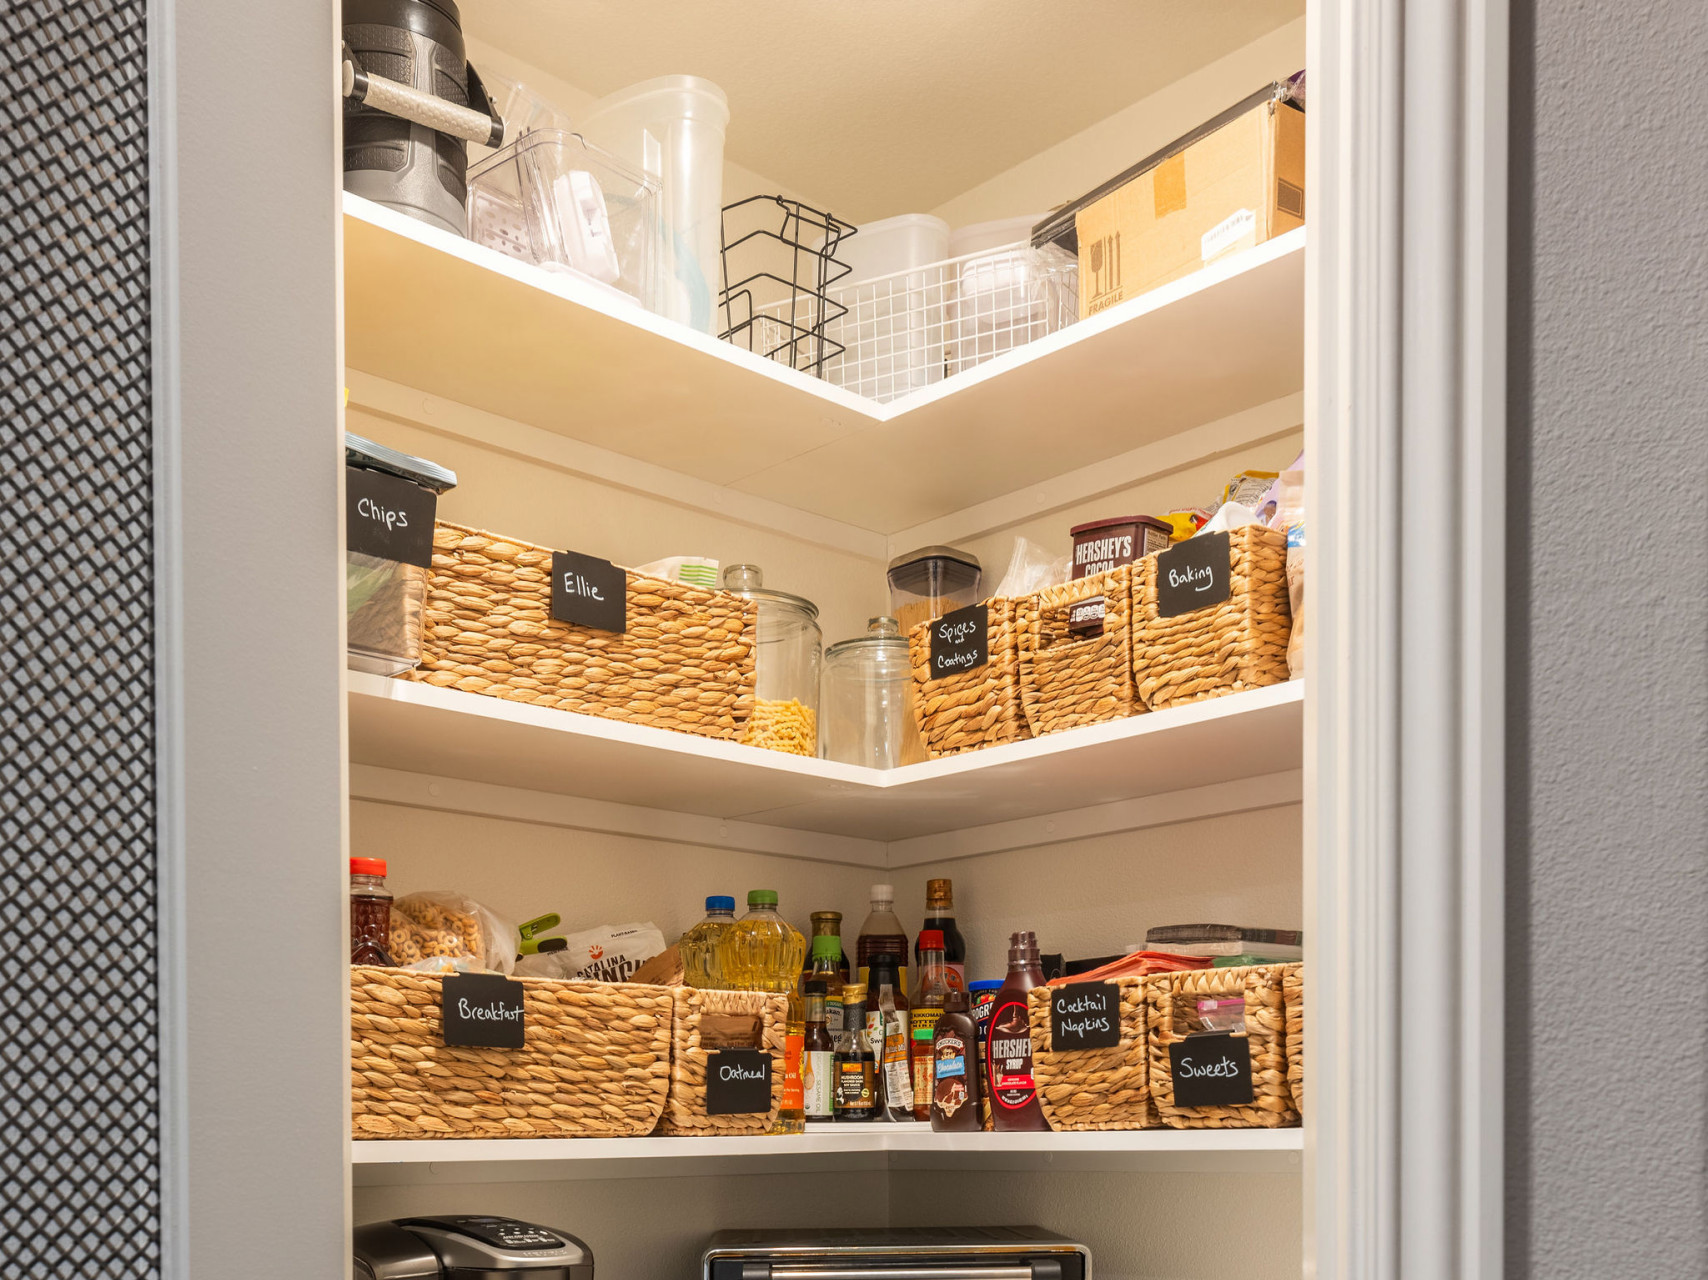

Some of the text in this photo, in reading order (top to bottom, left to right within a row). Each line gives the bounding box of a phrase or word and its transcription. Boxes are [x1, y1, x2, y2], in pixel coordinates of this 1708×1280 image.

[1088, 292, 1124, 316] FRAGILE
[357, 498, 408, 531] Chips
[1075, 535, 1132, 566] HERSHEY'S
[563, 571, 604, 601] Ellie
[1168, 565, 1213, 592] Baking
[938, 621, 976, 643] Spices
[937, 649, 978, 668] Coatings
[458, 998, 524, 1022] Breakfast
[1057, 994, 1106, 1014] Cocktail
[1061, 1017, 1110, 1038] Napkins
[719, 1064, 762, 1081] Oatmeal
[1005, 1059, 1024, 1070] SYRUP
[1179, 1056, 1239, 1078] Sweets
